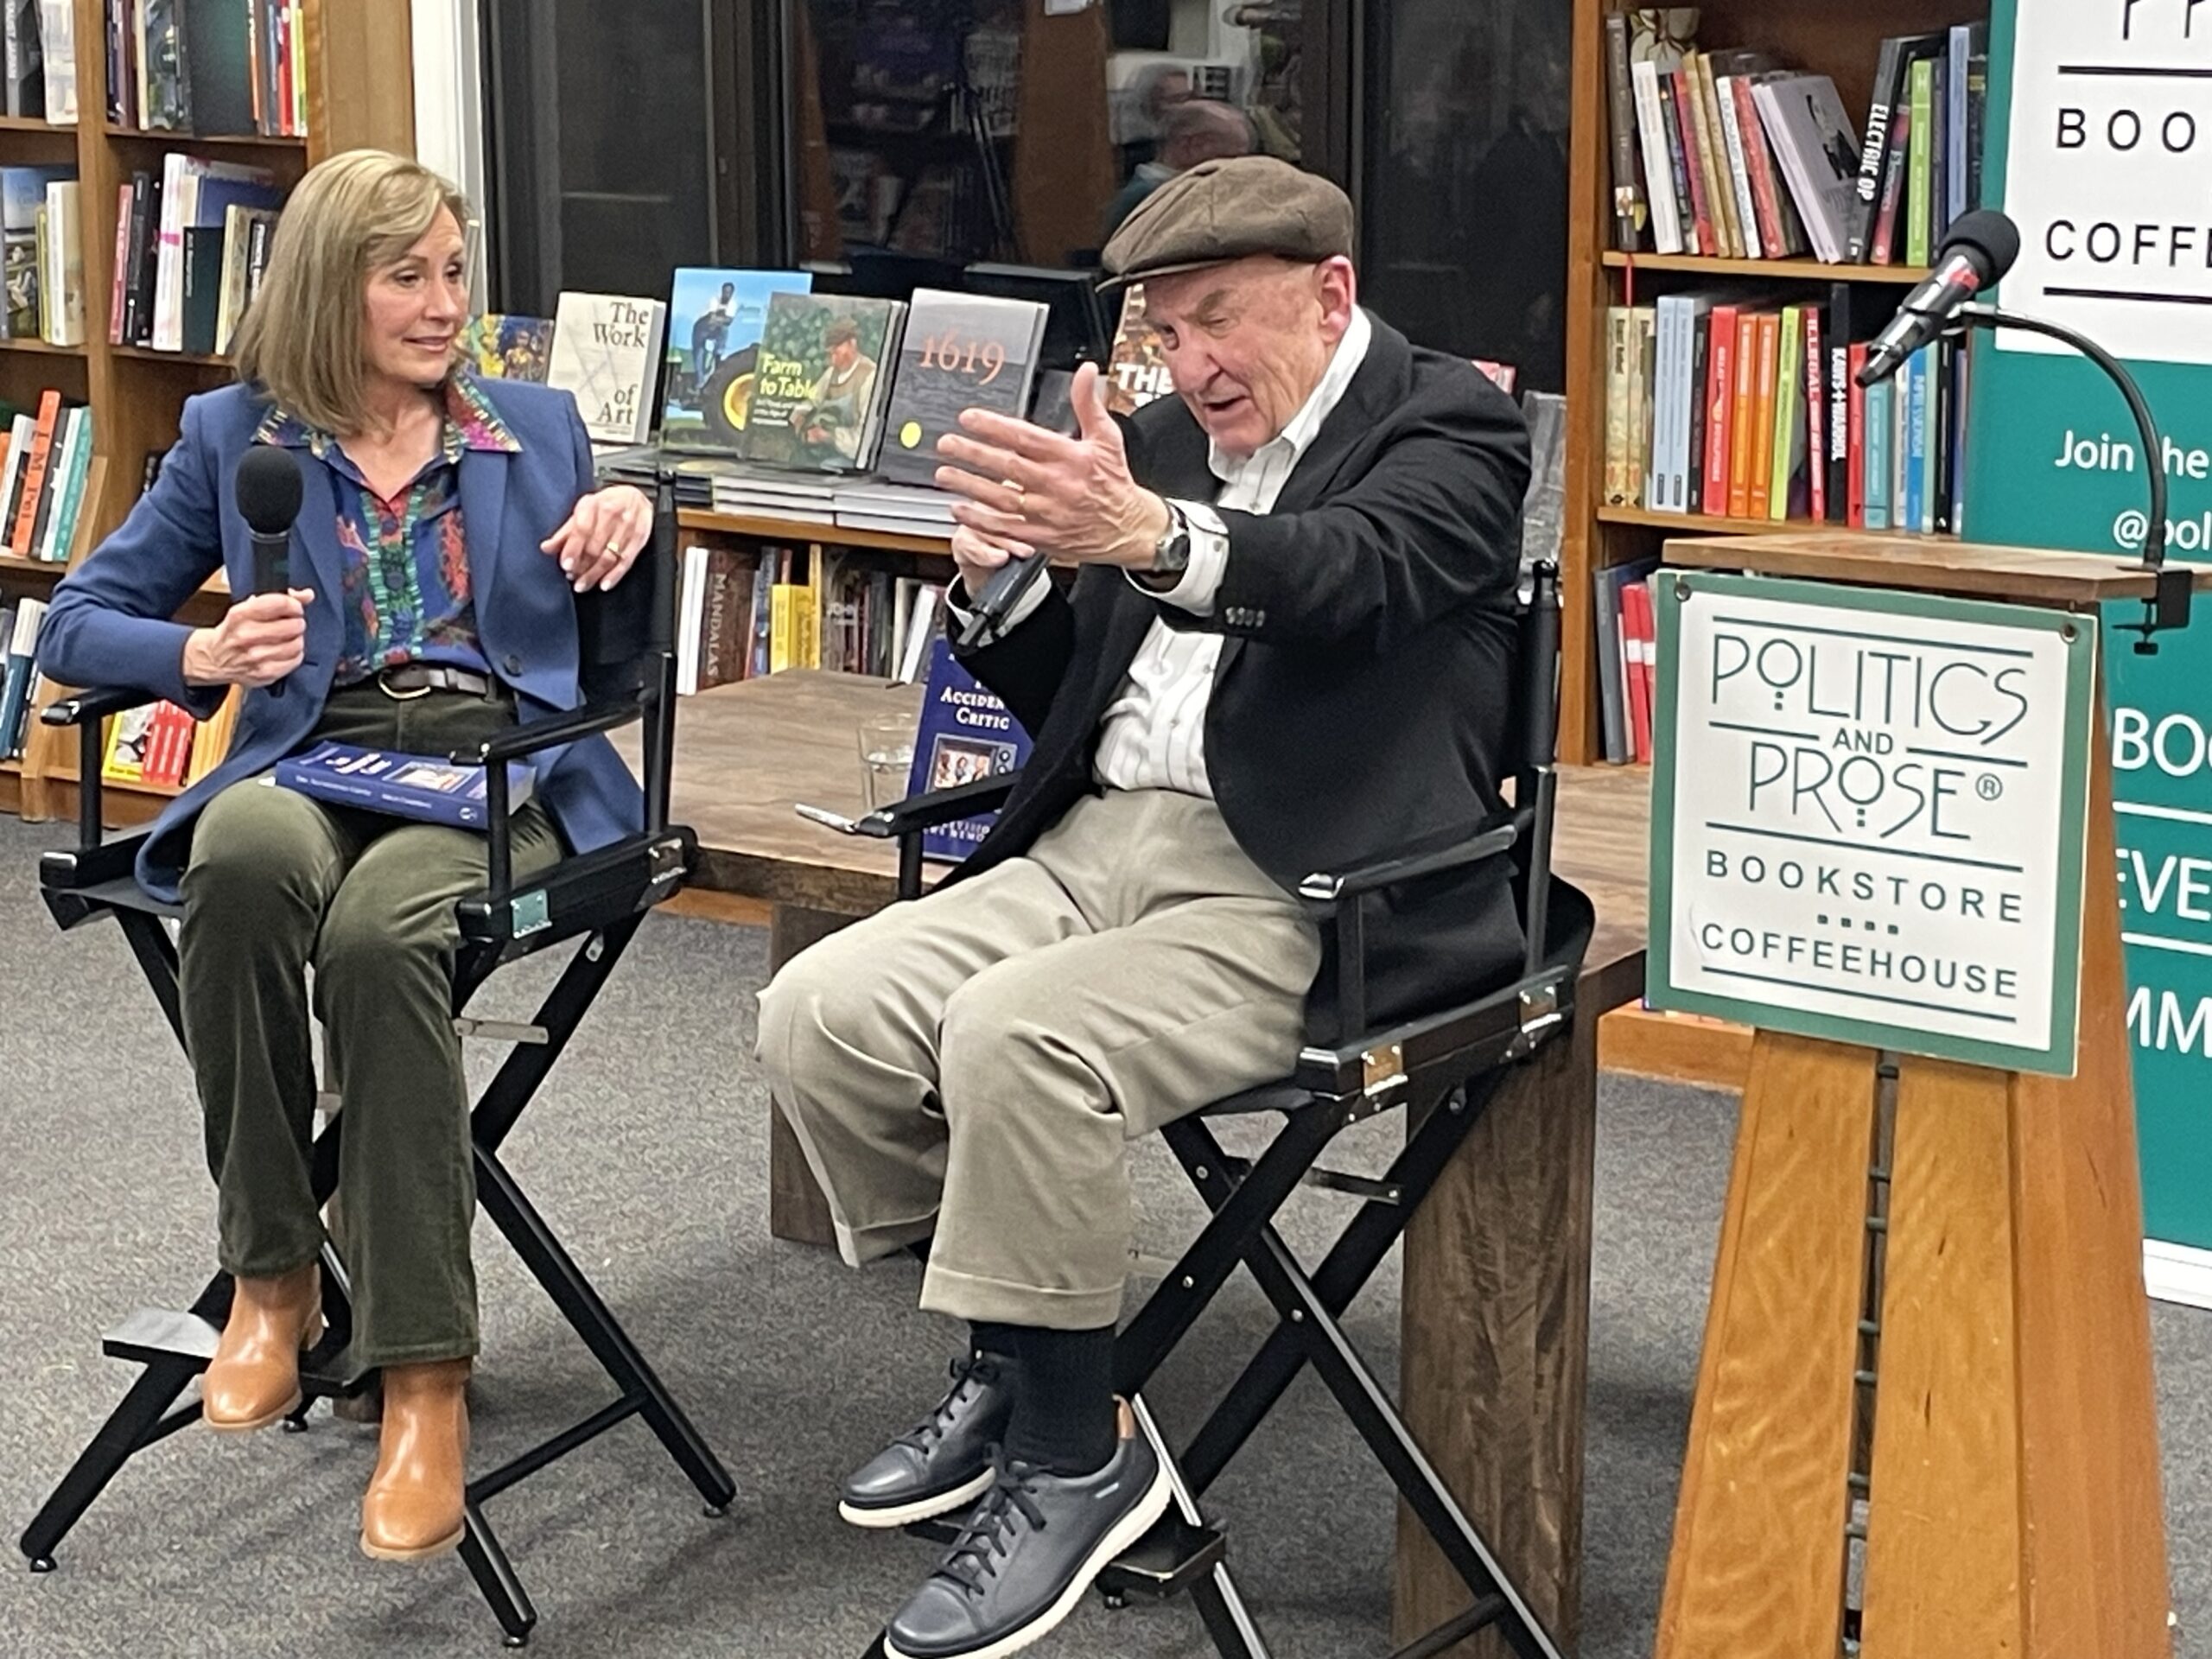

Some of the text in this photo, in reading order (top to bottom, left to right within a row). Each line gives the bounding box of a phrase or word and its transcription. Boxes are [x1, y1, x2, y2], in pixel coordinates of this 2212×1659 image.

[1857, 103, 1890, 201] ELECTRIC OP
[2056, 107, 2196, 154] BOO
[2045, 219, 2212, 269] COFF
[593, 322, 646, 348] Work
[609, 301, 650, 325] The
[762, 352, 803, 377] Farm
[918, 324, 1006, 386] 1619
[613, 384, 639, 406] of
[760, 378, 778, 395] to
[596, 401, 633, 425] Art
[2054, 429, 2210, 480] Join he
[707, 572, 729, 678] MANDALAS
[1711, 632, 2029, 745] POLITICS
[955, 706, 1011, 730] CRITIC
[1832, 727, 1895, 756] AND
[2112, 707, 2212, 778] BO
[1706, 849, 2023, 925] BOOKSTORE
[1700, 921, 2018, 999] COFFEEHOUSE
